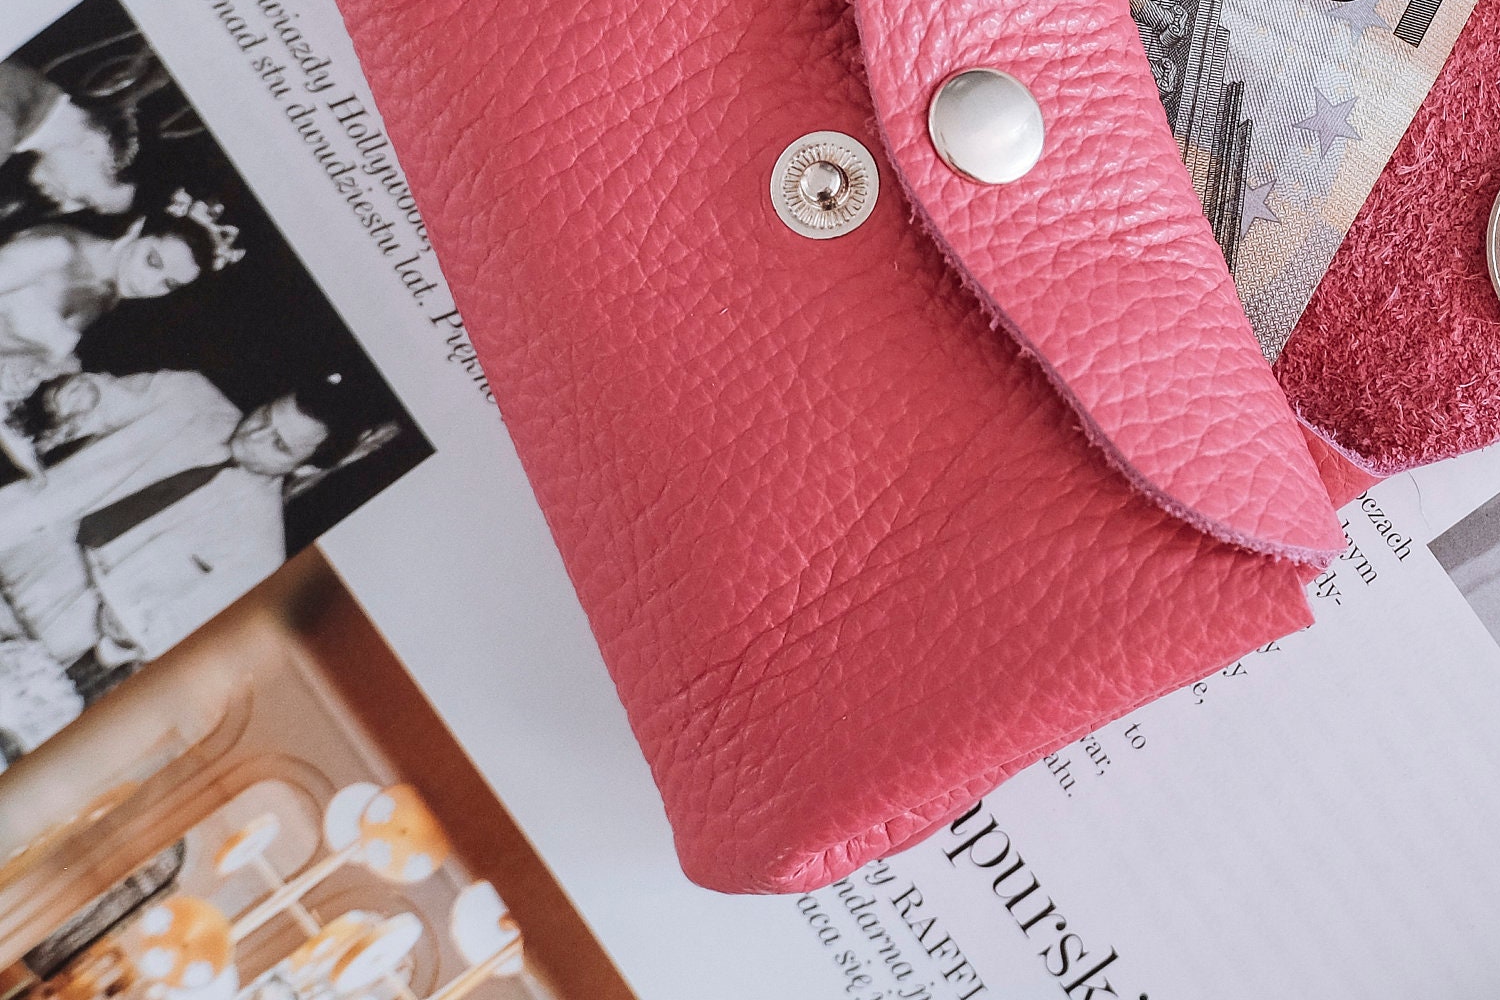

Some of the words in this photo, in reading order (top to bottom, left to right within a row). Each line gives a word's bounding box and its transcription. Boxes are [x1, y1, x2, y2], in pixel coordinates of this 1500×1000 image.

[252, 56, 291, 98] stu
[286, 103, 401, 257] dwudziestu
[394, 252, 438, 307] lat.
[1123, 722, 1147, 750] to
[834, 949, 873, 993] się
